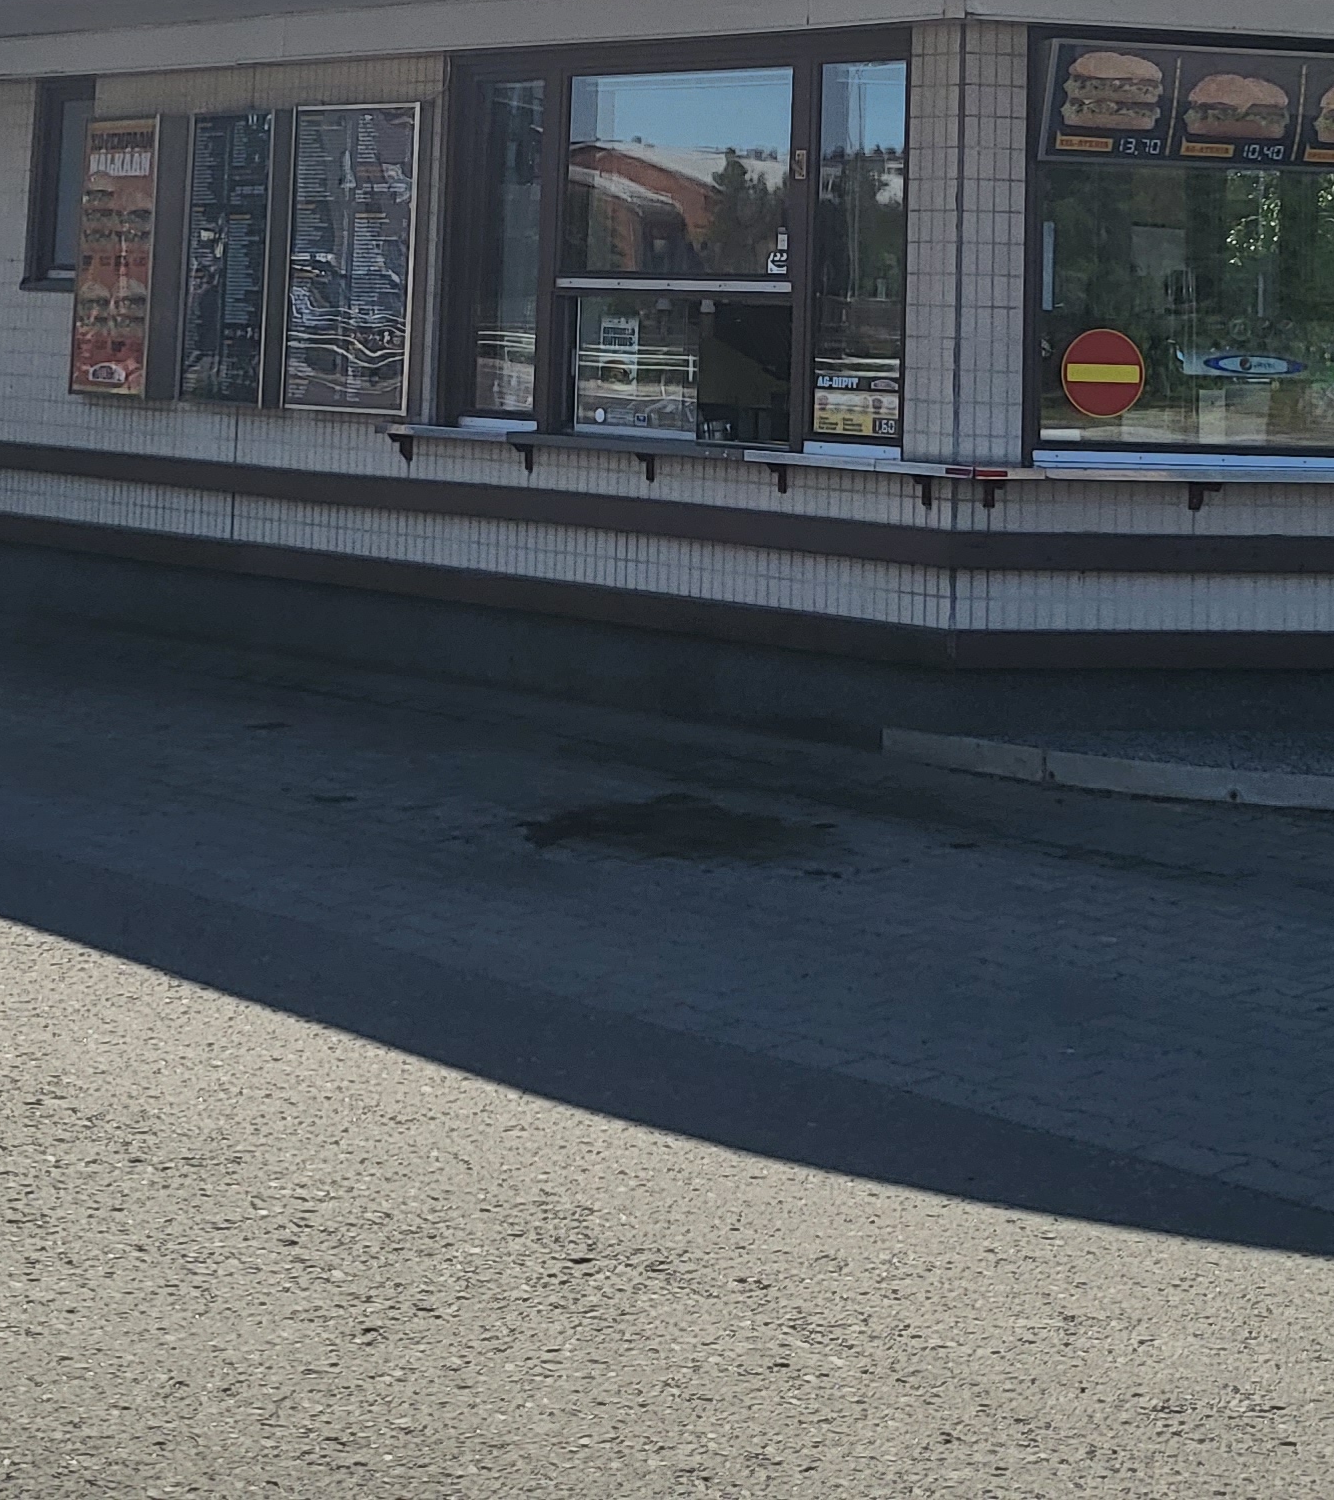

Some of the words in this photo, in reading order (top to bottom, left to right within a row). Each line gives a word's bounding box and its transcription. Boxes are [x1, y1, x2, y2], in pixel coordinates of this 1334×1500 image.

[1119, 138, 1161, 155] 13,70
[1243, 144, 1284, 160] 10,40
[817, 376, 858, 388] AG-DIPIT
